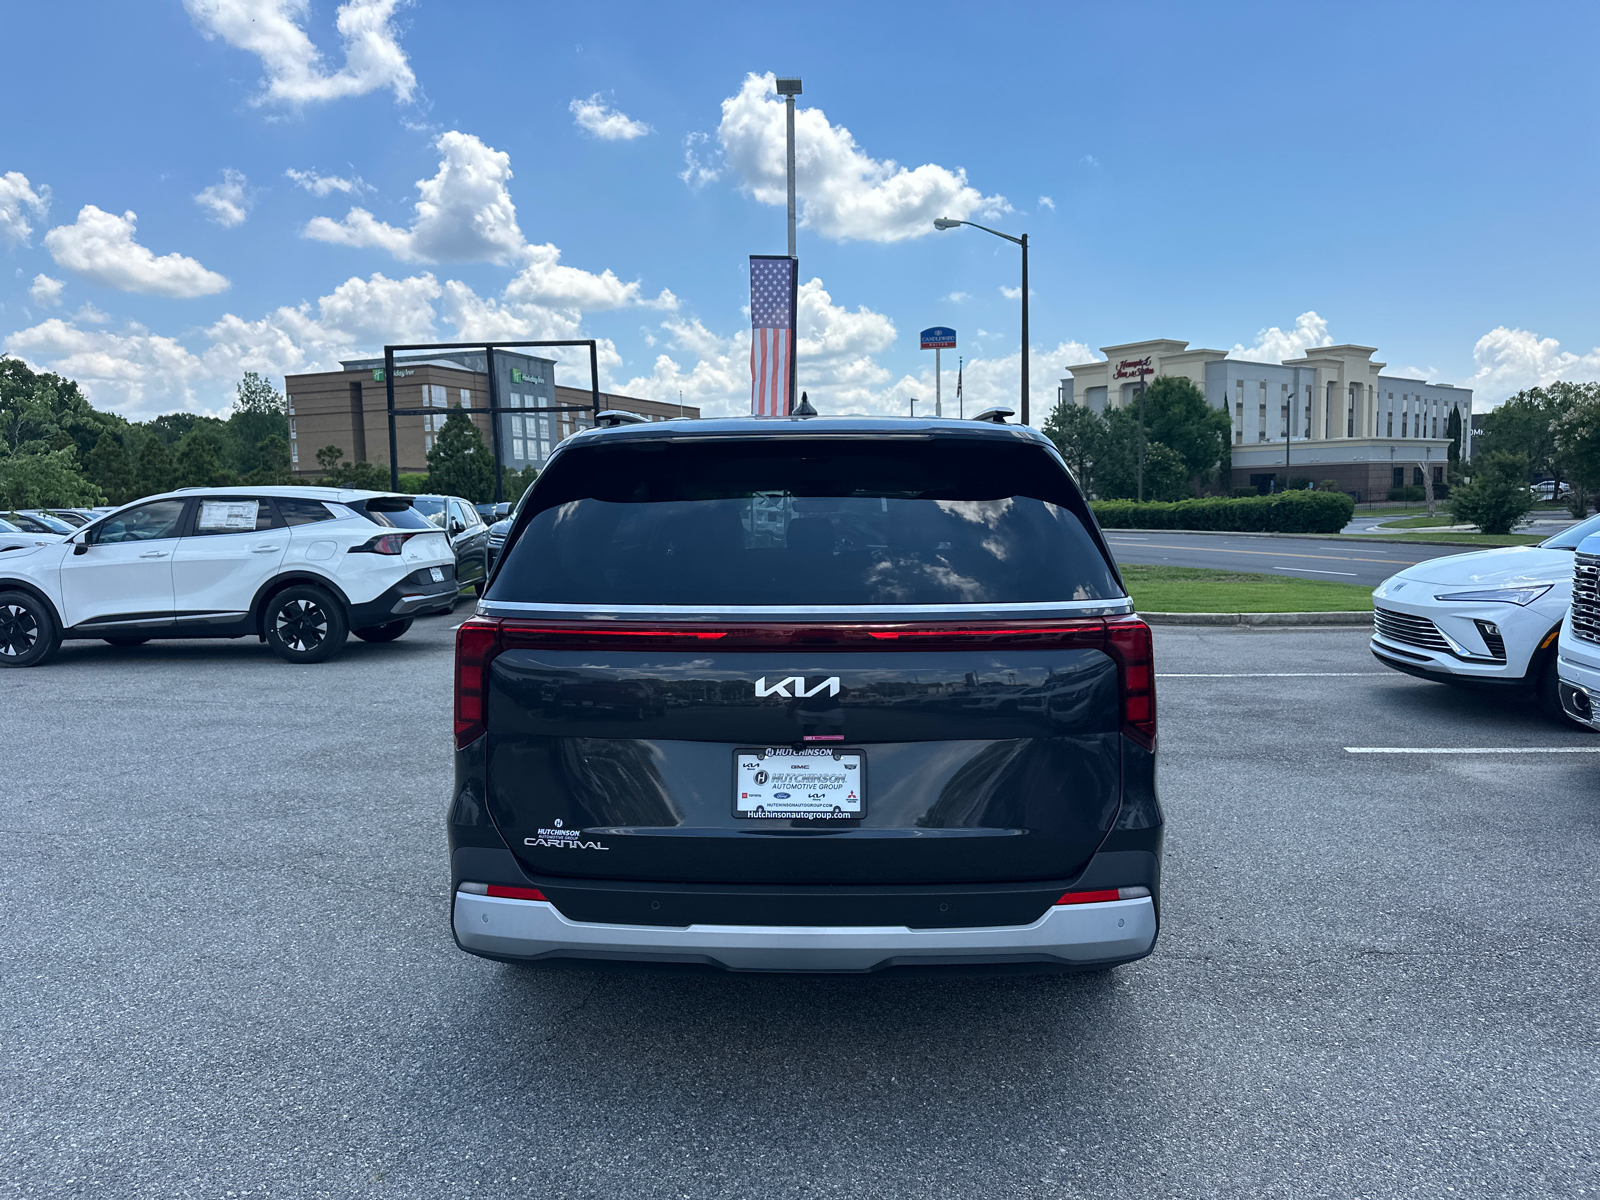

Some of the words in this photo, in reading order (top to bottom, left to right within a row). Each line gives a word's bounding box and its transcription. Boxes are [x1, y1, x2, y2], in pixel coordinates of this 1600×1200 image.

[1135, 367, 1154, 377] Sites
[755, 676, 840, 697] KIA
[775, 748, 833, 756] HUTCHINSON
[771, 773, 847, 783] HUTCHINSON
[747, 810, 851, 820] Hutchinsonautogroup.com
[537, 828, 580, 836] HUTCHINSON
[524, 838, 609, 850] CARNIVAL
